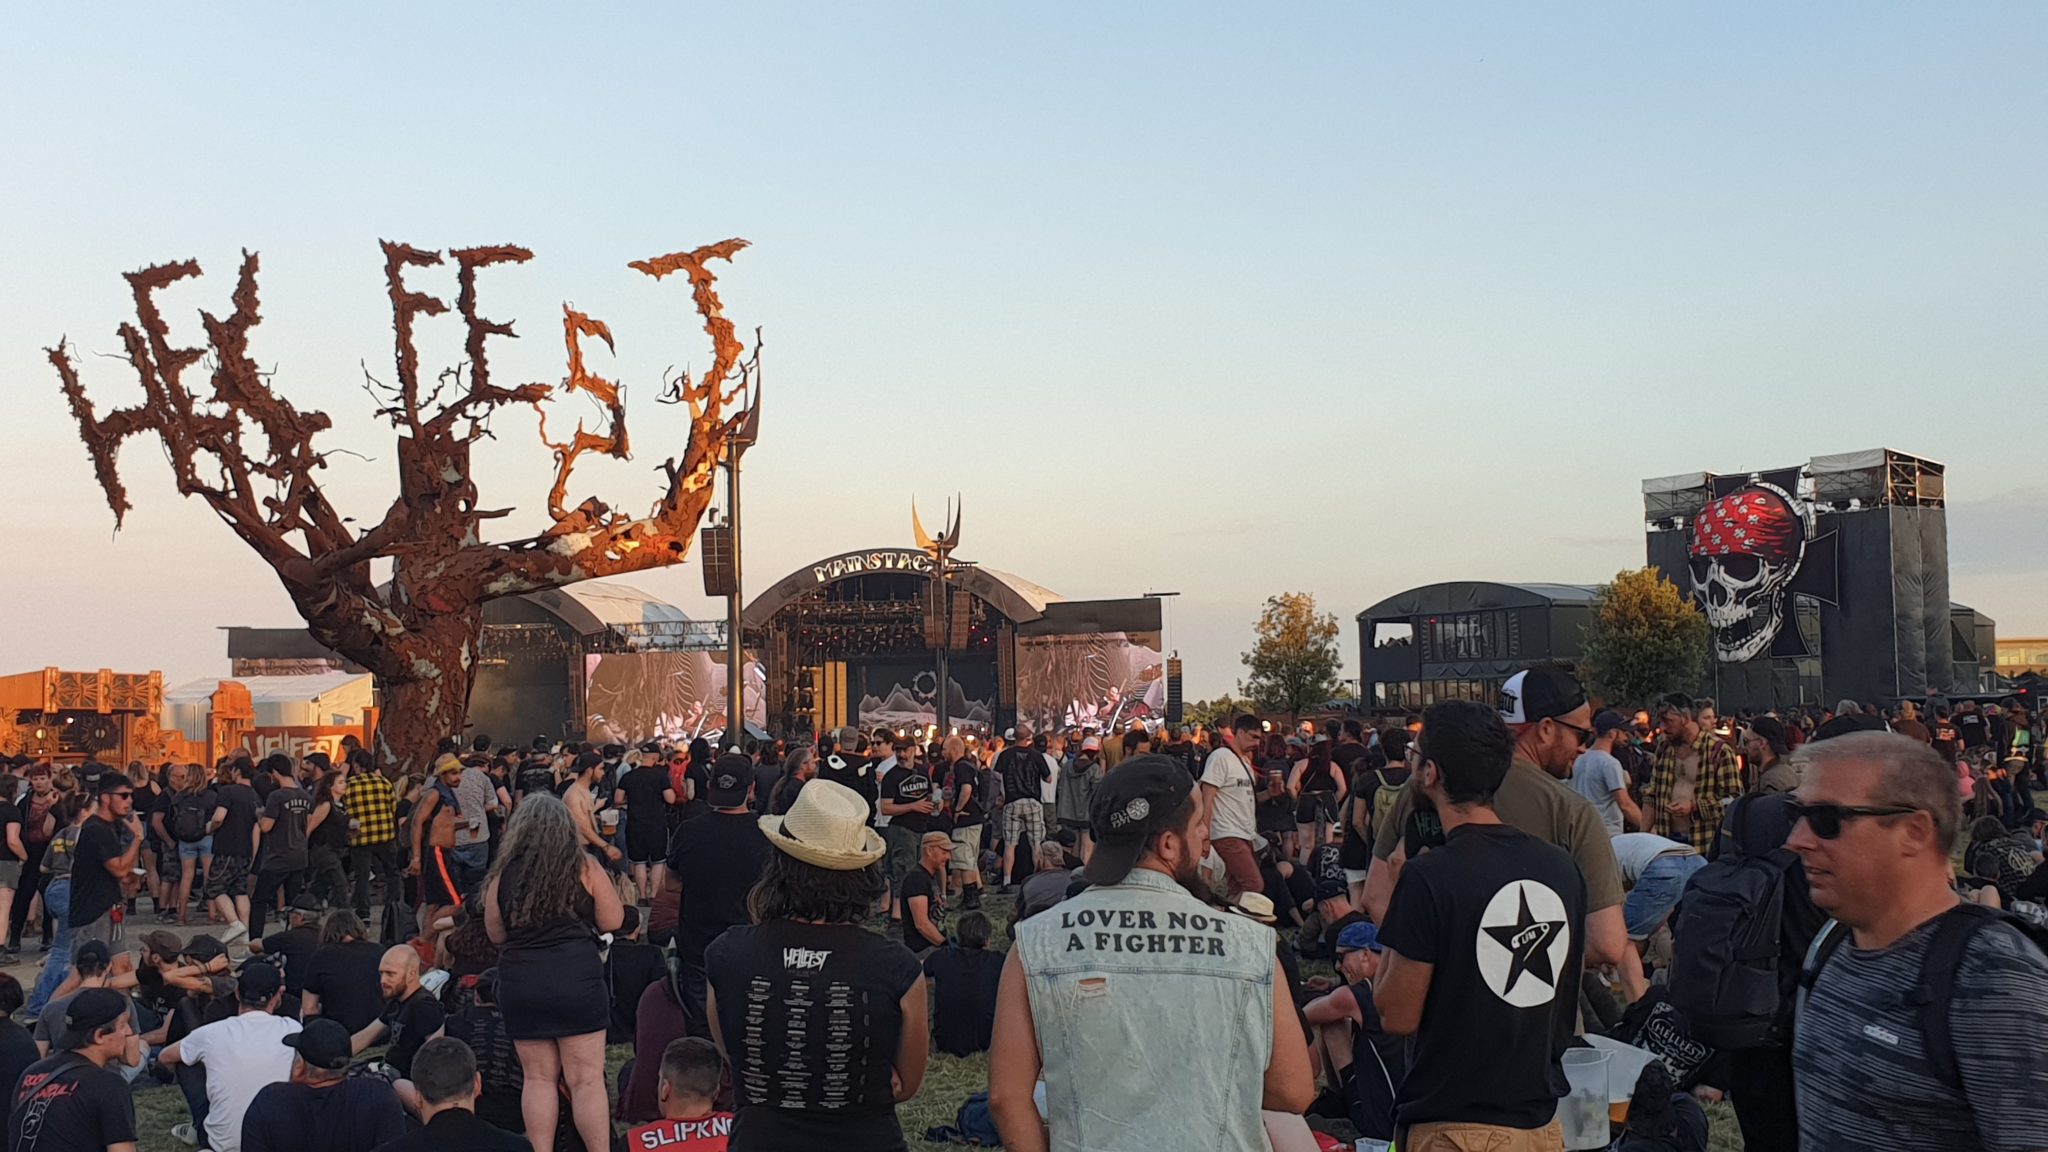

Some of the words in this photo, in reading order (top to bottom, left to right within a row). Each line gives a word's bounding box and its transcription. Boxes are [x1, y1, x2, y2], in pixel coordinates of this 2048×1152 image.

[813, 552, 934, 584] MAINSTAG
[1062, 909, 1157, 929] LOVER
[1168, 911, 1227, 934] NOT
[1066, 932, 1085, 953] A
[1095, 932, 1227, 957] FIGHTER
[782, 946, 833, 972] HELLFEST
[1655, 1022, 1703, 1062] HELLFEST
